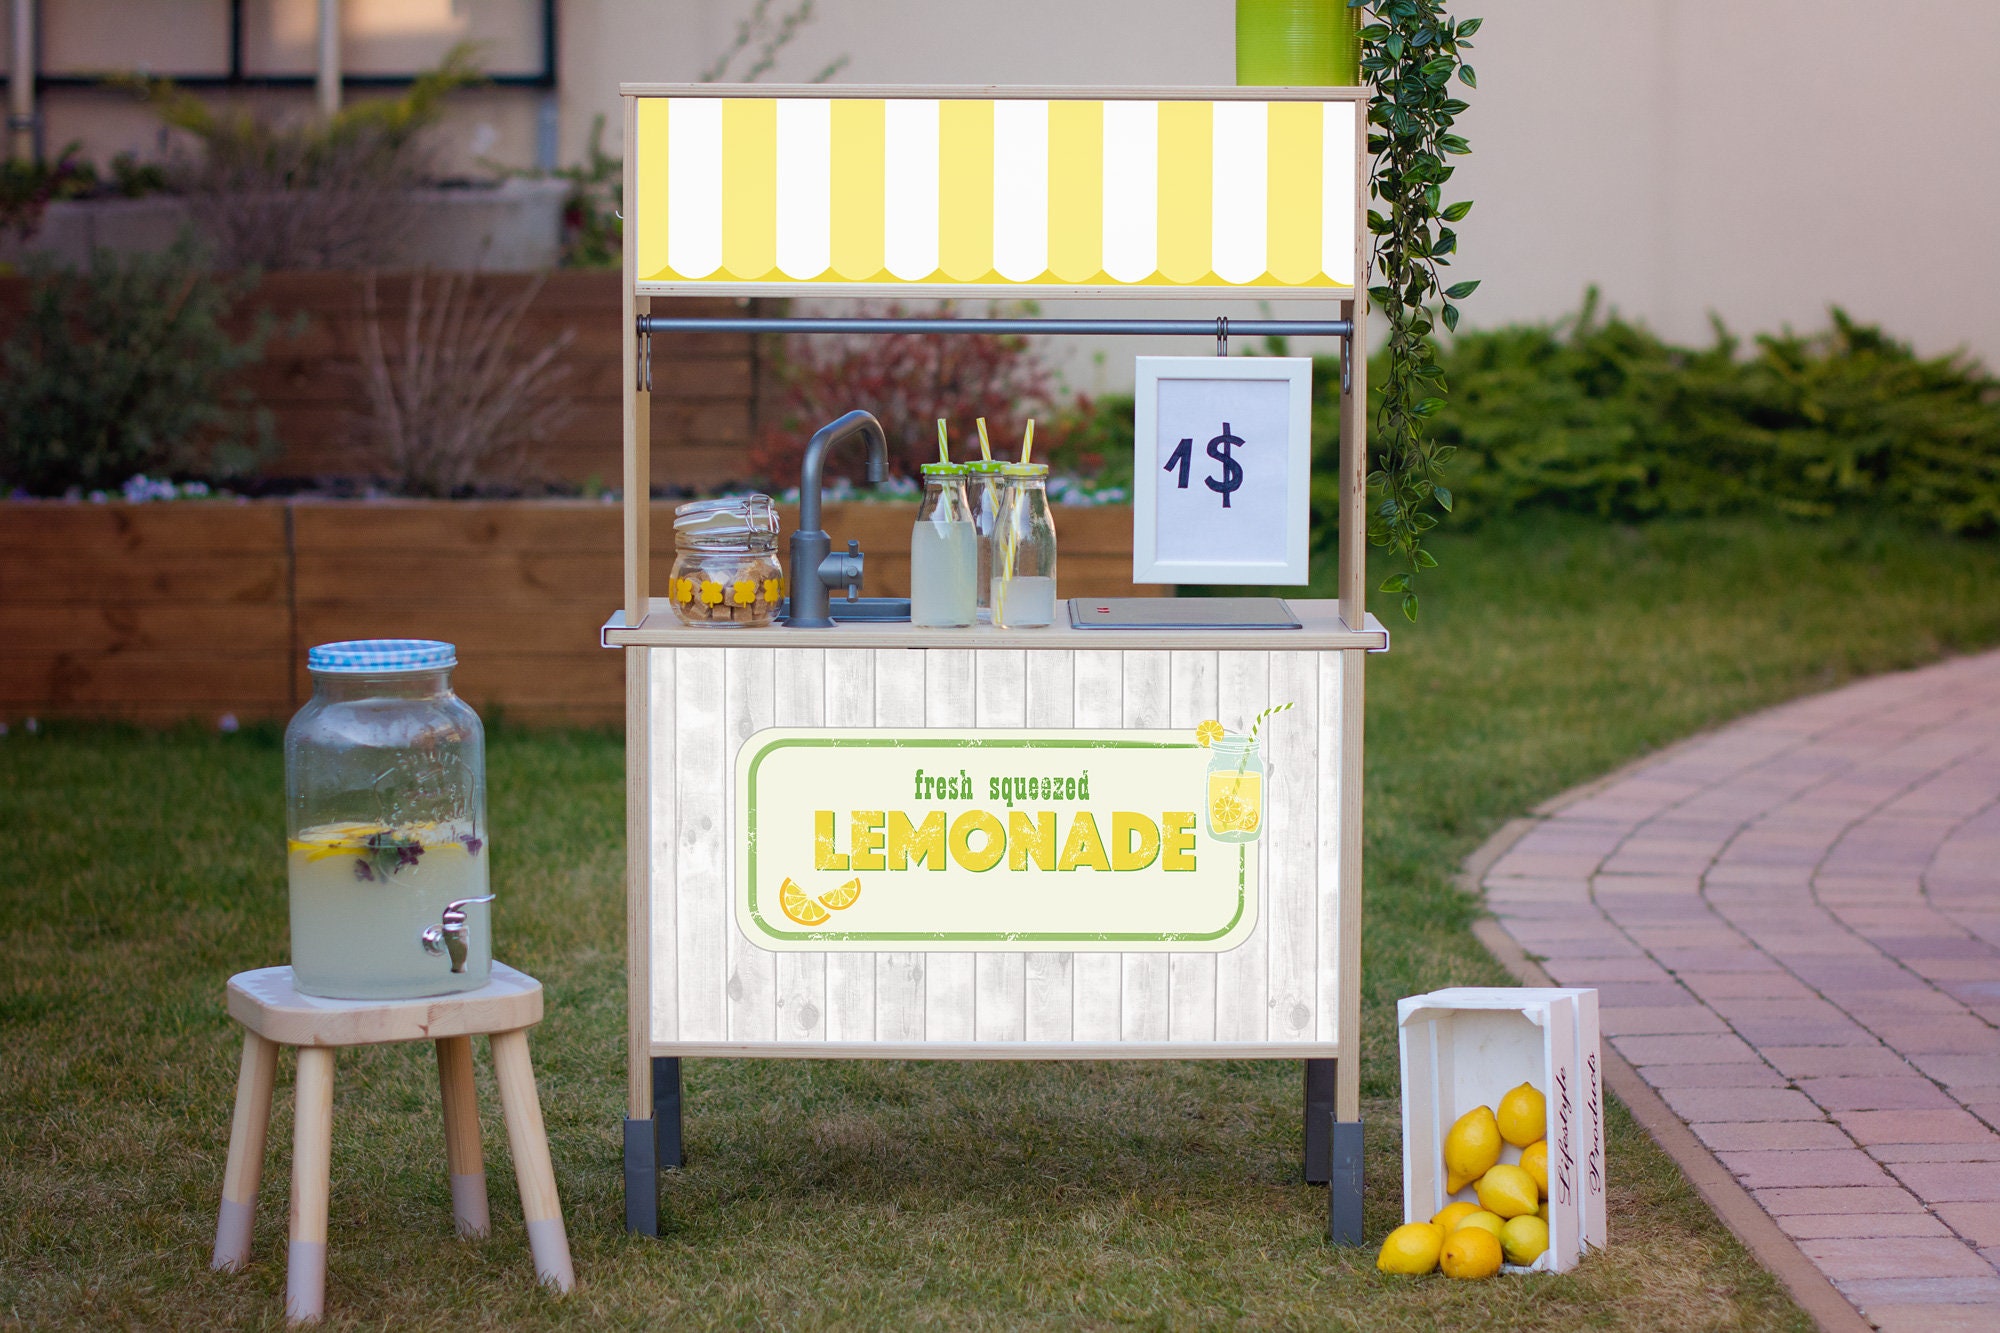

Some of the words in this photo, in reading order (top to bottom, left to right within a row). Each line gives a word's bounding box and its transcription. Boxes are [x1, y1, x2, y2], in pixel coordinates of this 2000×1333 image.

[1163, 421, 1246, 509] 1$
[915, 769, 973, 800] fresh
[989, 770, 1090, 807] squeezed
[814, 809, 1198, 873] LEMONADE
[1555, 1066, 1574, 1206] Lifestyle
[1588, 1052, 1601, 1196] Products
